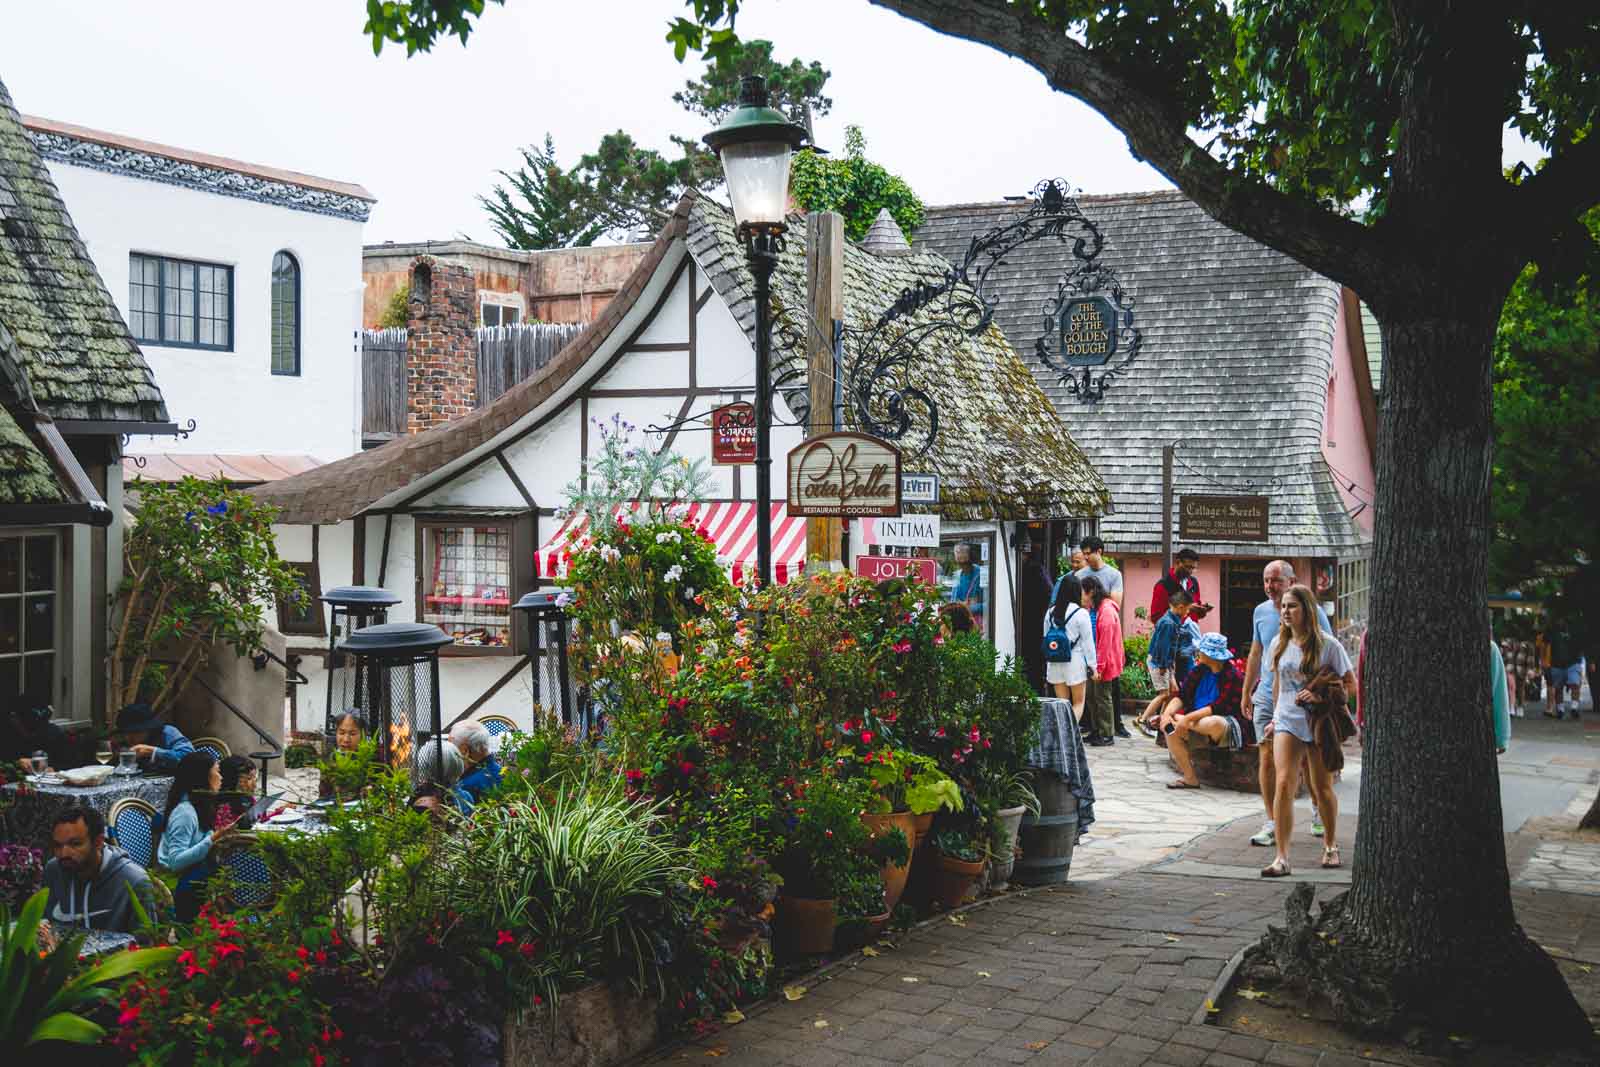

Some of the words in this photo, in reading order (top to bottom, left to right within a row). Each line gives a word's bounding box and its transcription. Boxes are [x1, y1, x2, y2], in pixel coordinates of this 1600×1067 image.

[1079, 303, 1095, 311] THE
[1071, 312, 1100, 321] COURT
[1071, 322, 1082, 331] OF
[1085, 321, 1102, 329] THE
[1064, 331, 1108, 343] GOLDEN
[1066, 342, 1106, 354] BOUGH
[803, 506, 841, 514] RESTAURANT
[846, 506, 882, 514] COCKTAILS
[881, 521, 934, 538] INTIMA
